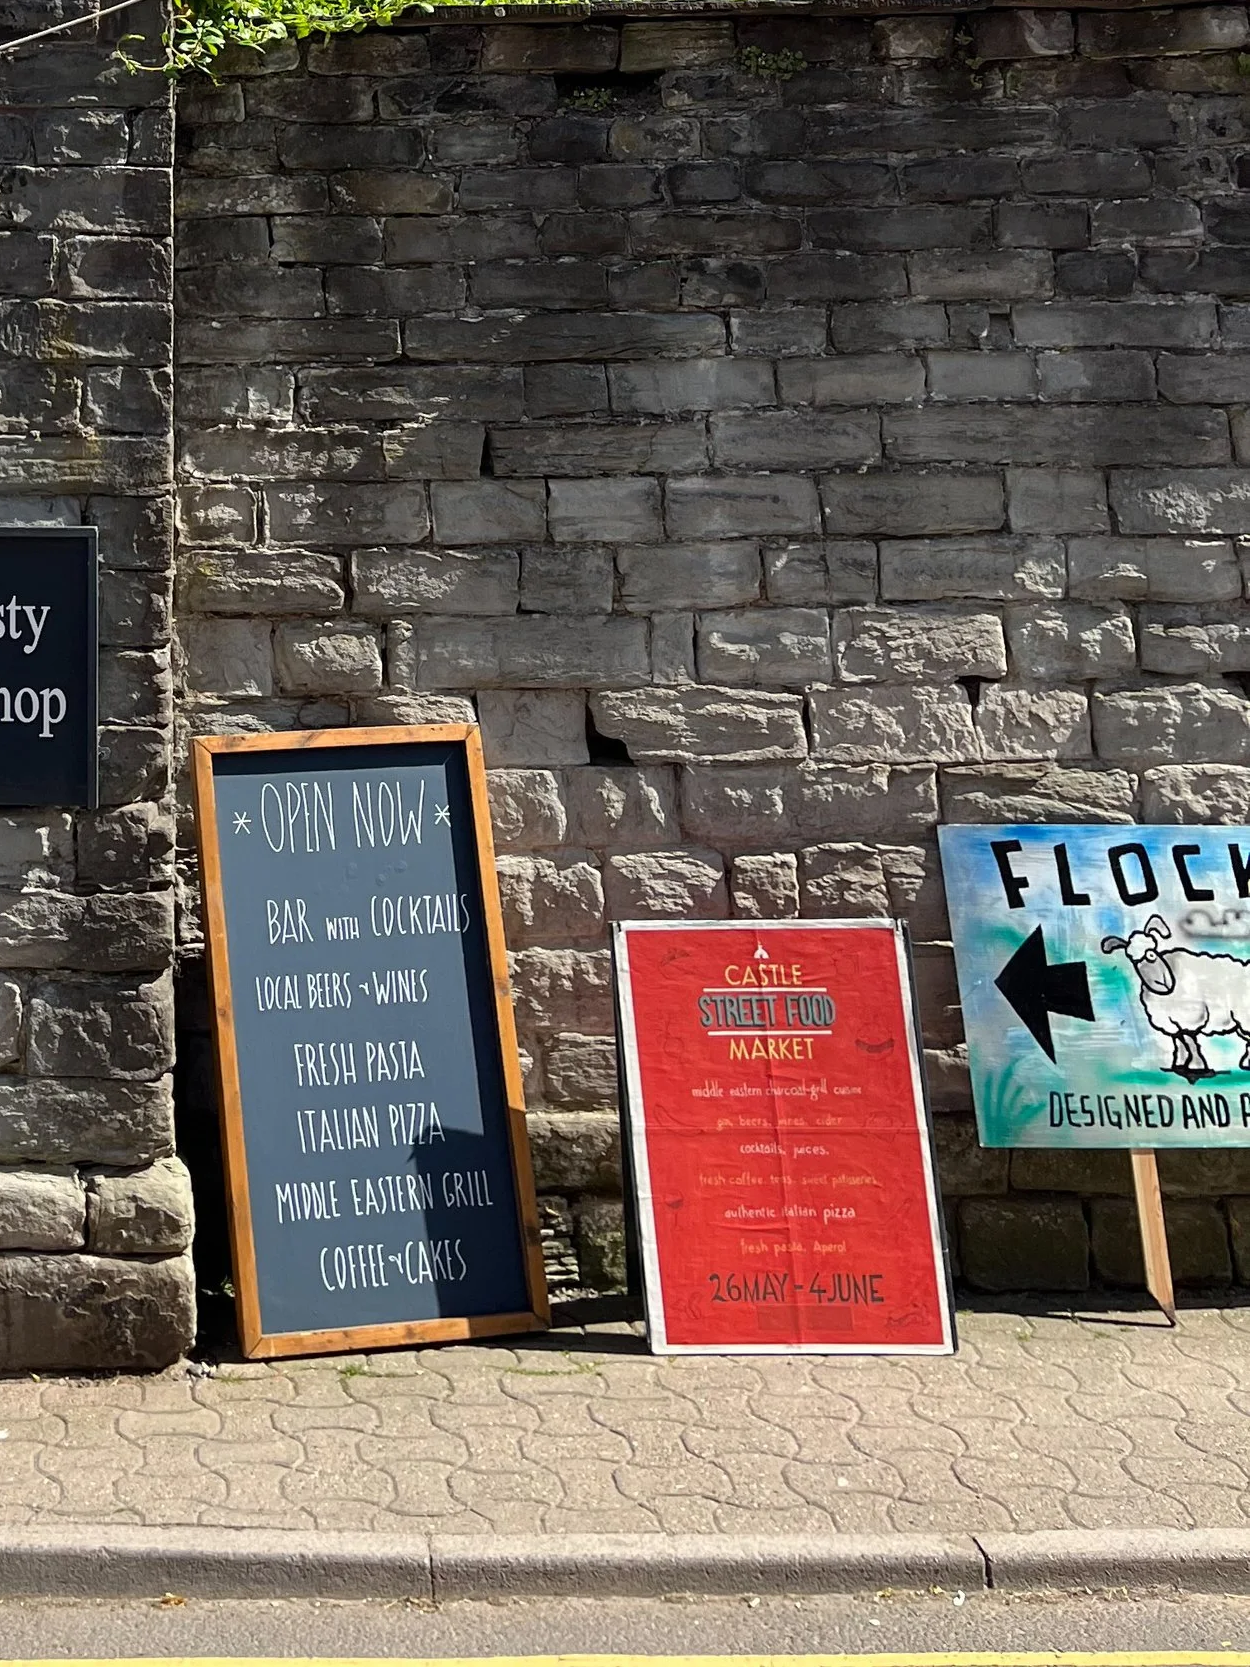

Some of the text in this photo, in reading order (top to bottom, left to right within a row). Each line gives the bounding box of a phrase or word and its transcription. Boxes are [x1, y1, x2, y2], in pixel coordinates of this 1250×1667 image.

[261, 779, 425, 853] OPEN NOW
[266, 893, 470, 944] BAR WITH COCKTAILS
[255, 974, 302, 1012] LOCAL
[306, 972, 352, 1009] BEERS
[372, 969, 428, 1005] WINES
[724, 964, 802, 986] CASTLE
[698, 994, 836, 1027] STREET FOOD
[294, 1040, 425, 1087] FRESH PASTA
[729, 1037, 814, 1060] MARKET
[692, 1079, 723, 1097] middle
[729, 1081, 762, 1097] eastern
[816, 1114, 843, 1126] cider
[1049, 1091, 1174, 1130] DESIGNED
[1181, 1092, 1231, 1130] AND
[297, 1102, 445, 1154] ITALIAN PIZZA
[699, 1172, 725, 1187] fresh
[802, 1173, 828, 1185] sweet
[275, 1170, 494, 1224] MIDDLE EASTERN GRILL
[724, 1203, 856, 1225] authentic italian pizza
[740, 1238, 768, 1254] fresh
[813, 1240, 847, 1255] Aperol
